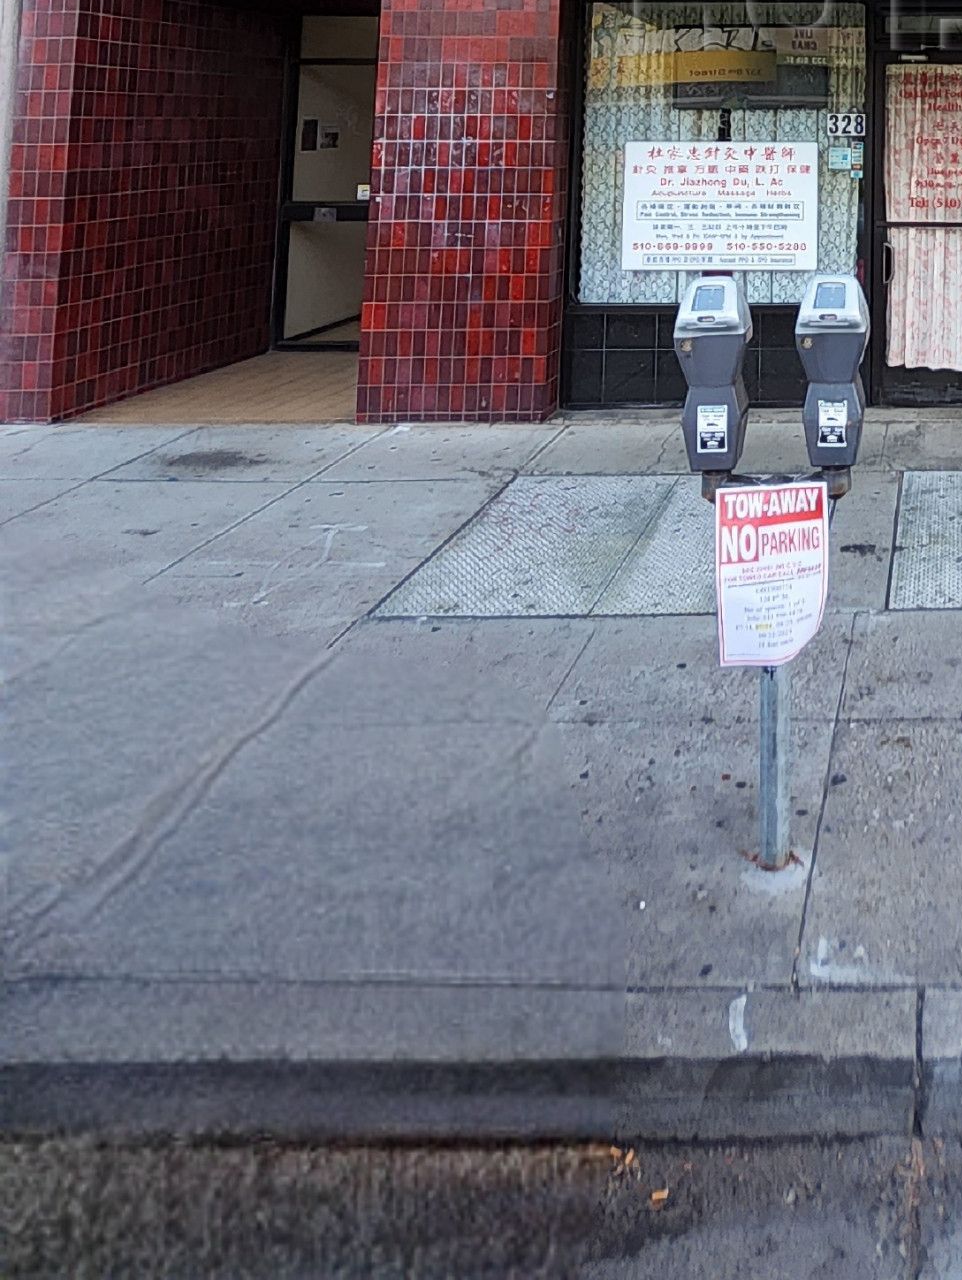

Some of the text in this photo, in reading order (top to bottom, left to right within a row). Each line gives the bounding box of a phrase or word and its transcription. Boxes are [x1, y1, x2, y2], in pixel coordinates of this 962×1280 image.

[828, 114, 864, 135] 328
[660, 177, 675, 187] Dr.
[724, 488, 819, 519] TOW-AWAY
[721, 523, 820, 563] NO PARKING
